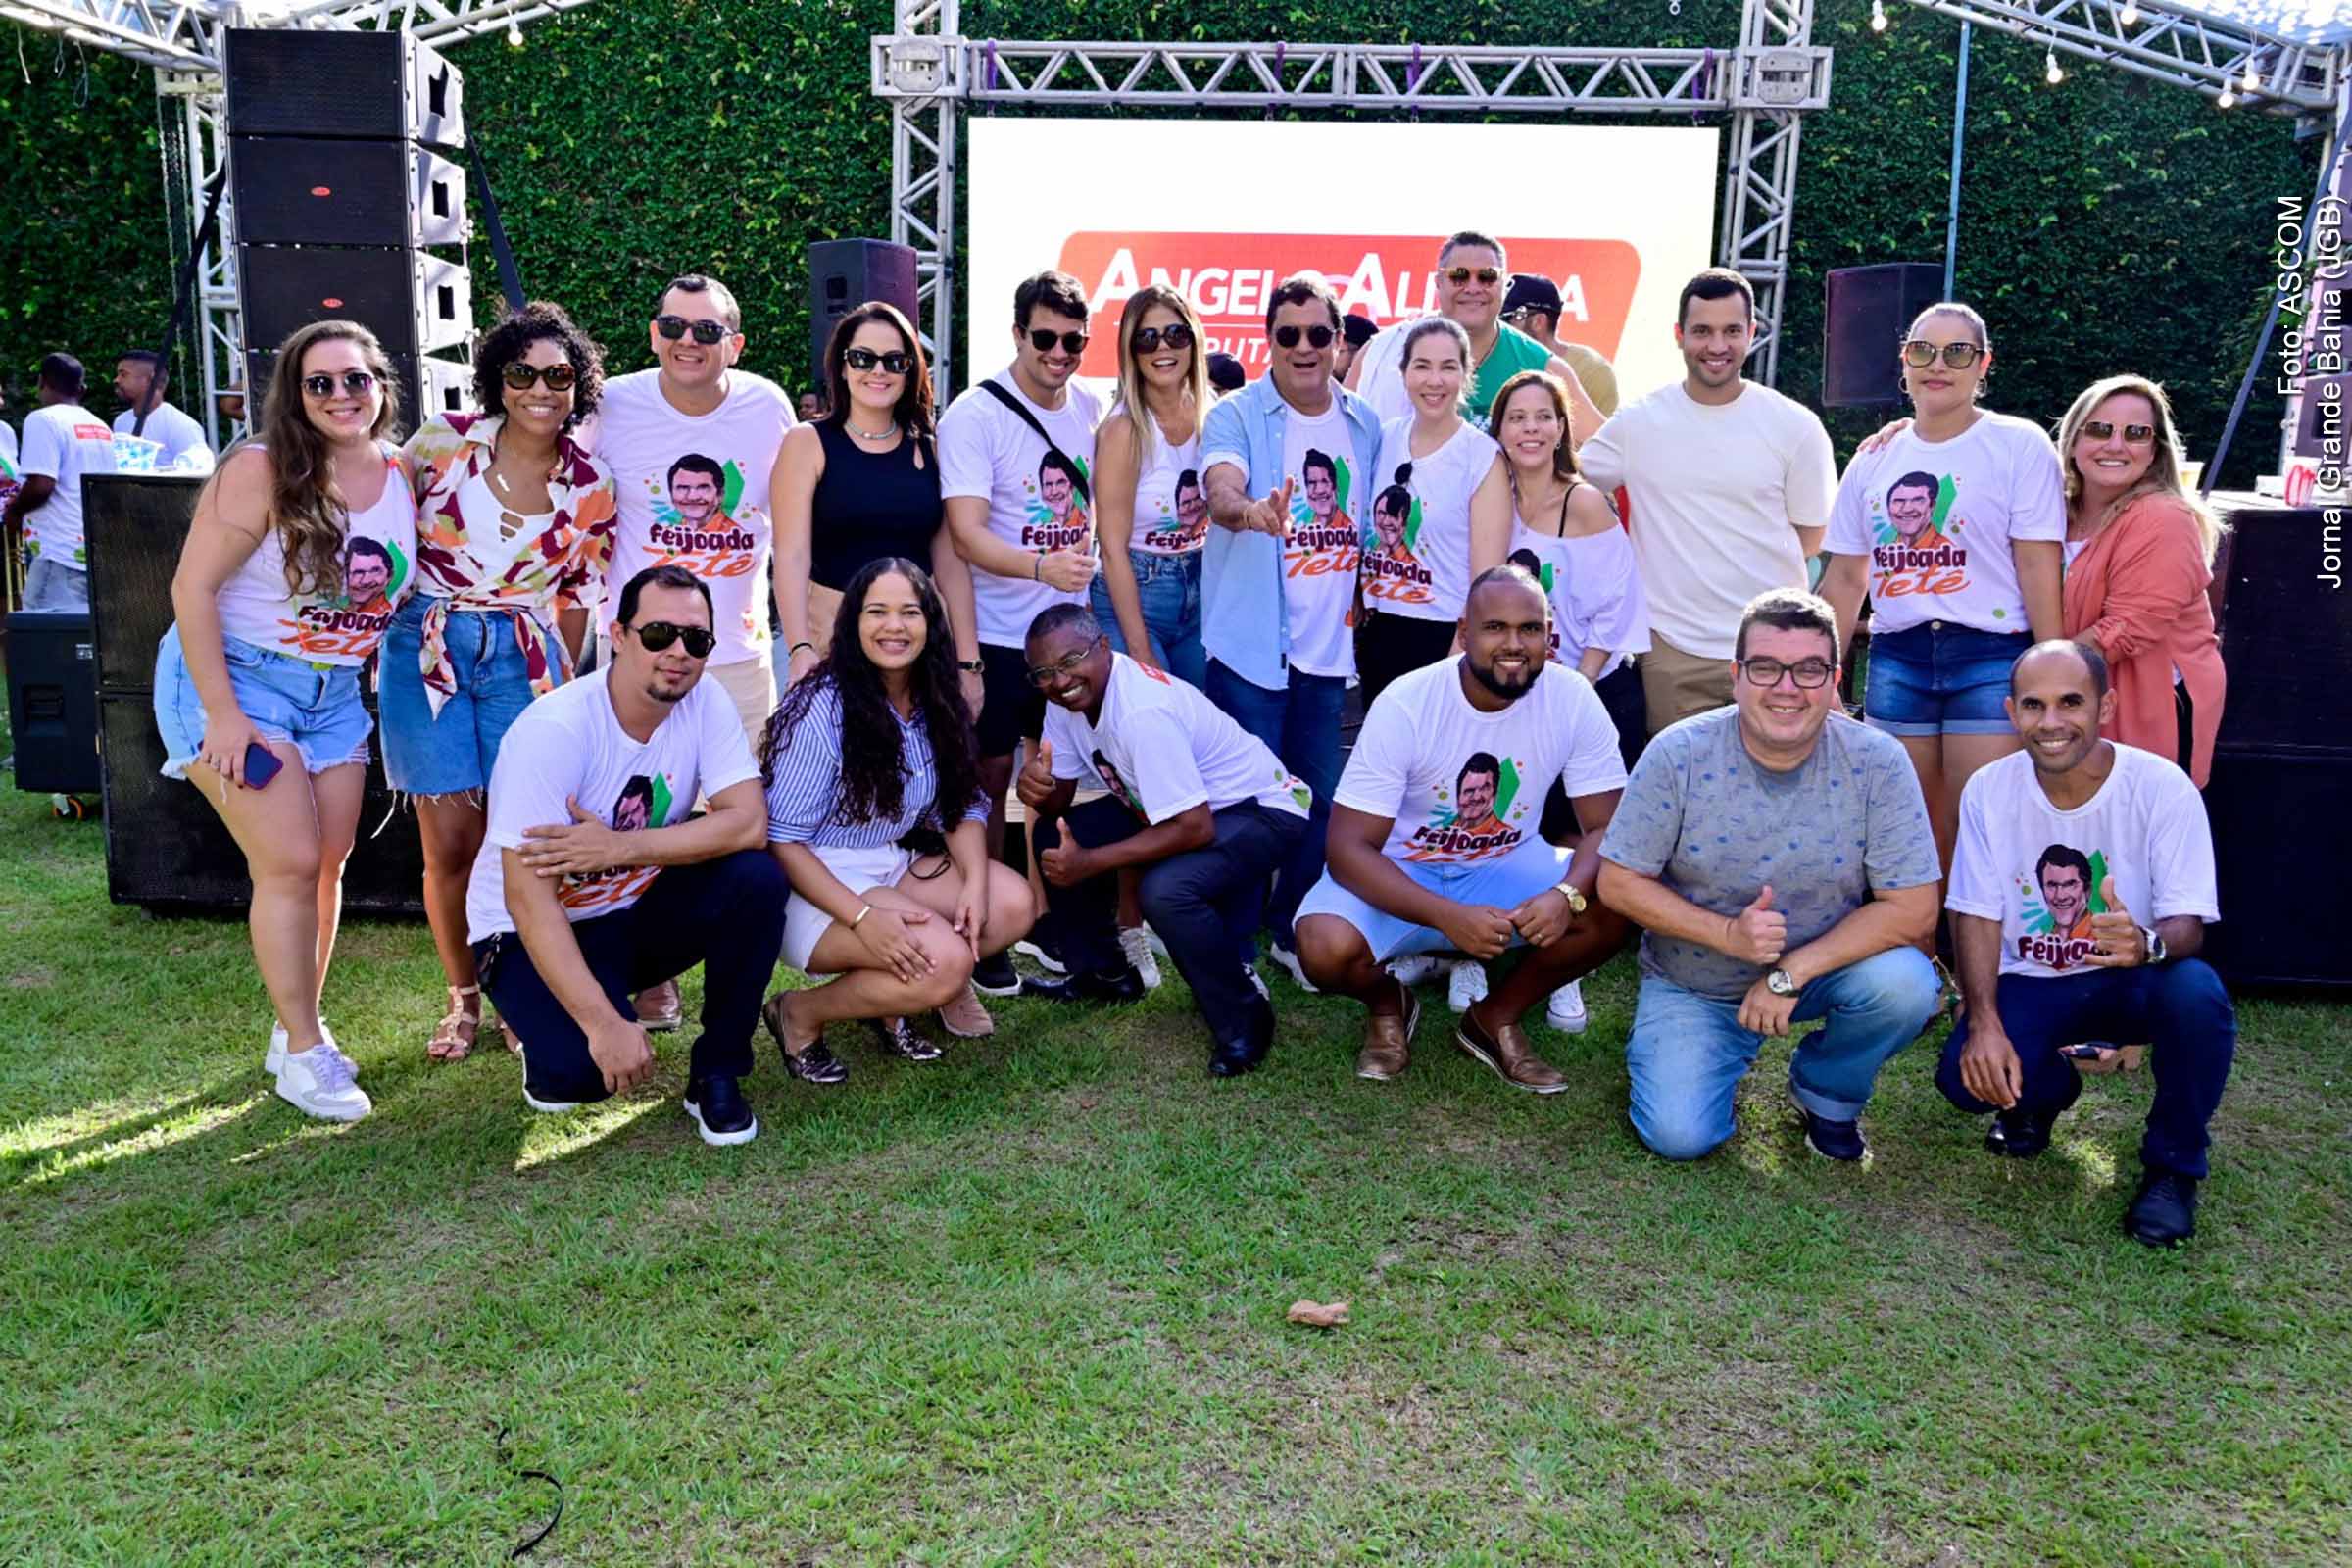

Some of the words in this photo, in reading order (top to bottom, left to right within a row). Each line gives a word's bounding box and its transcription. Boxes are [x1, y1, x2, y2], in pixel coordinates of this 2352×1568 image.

[650, 523, 754, 554] Feijoada
[1021, 523, 1090, 552] Feijoa
[1362, 552, 1432, 585] eijoada
[1873, 545, 1967, 573] Feijoada
[1874, 564, 1971, 599] Tetê
[1413, 826, 1522, 853] Feijoada
